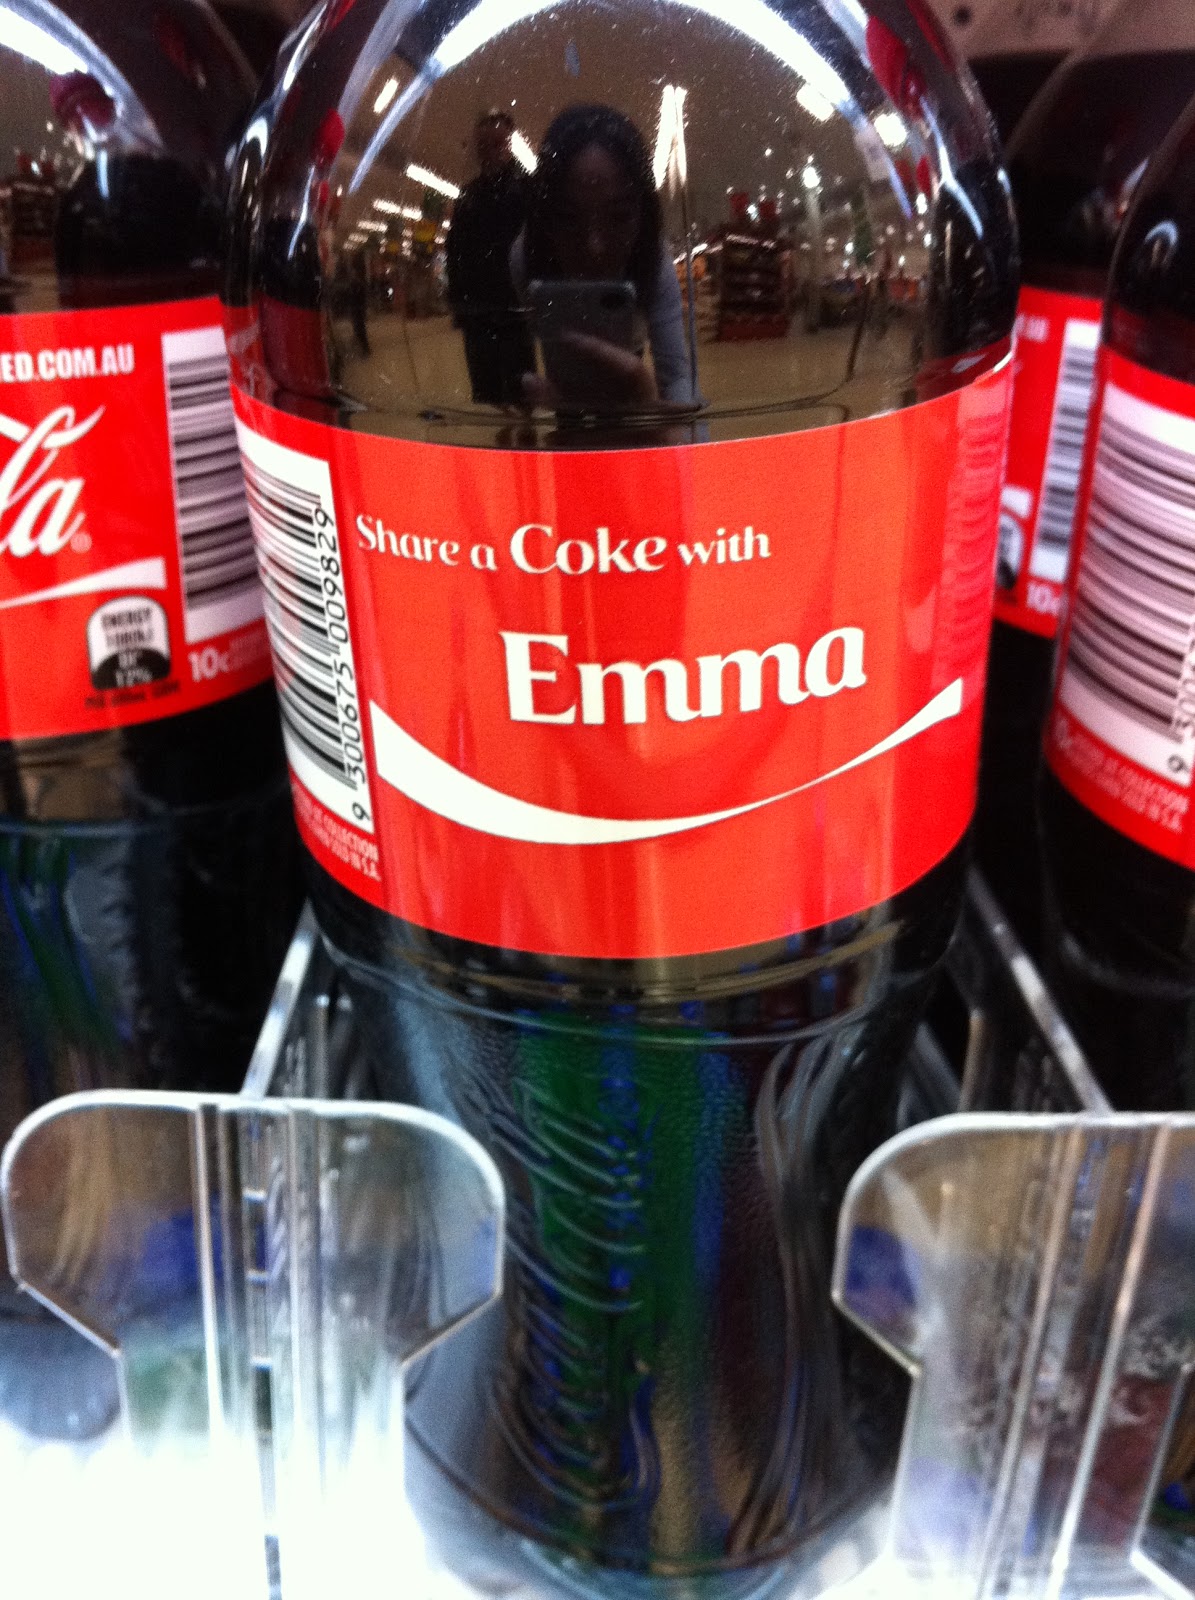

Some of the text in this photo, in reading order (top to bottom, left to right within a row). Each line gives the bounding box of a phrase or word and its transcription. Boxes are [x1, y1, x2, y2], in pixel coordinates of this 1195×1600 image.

[356, 514, 772, 575] Share a Coke with
[314, 507, 370, 821] 9 300675 009829
[500, 626, 867, 725] Emma
